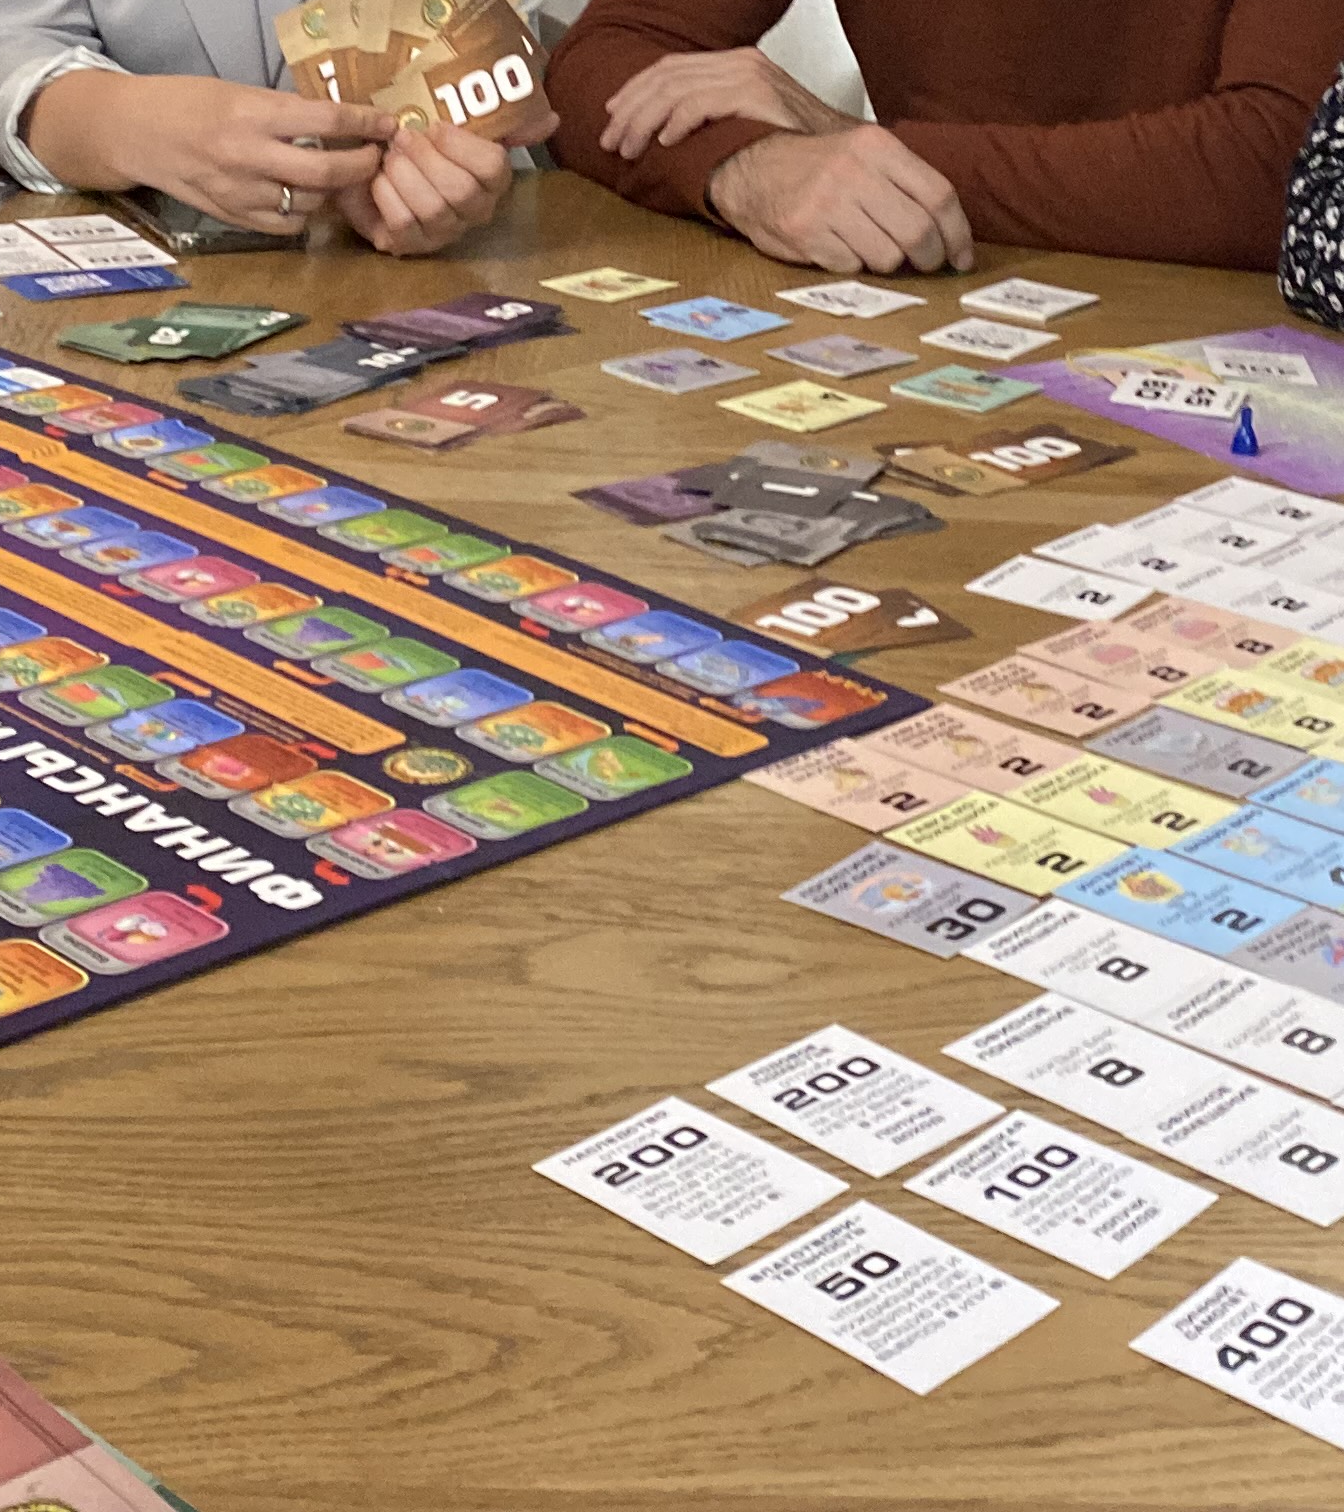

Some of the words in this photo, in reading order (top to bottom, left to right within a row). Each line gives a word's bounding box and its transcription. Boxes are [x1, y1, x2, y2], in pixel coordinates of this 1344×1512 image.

[434, 53, 534, 127] 100
[440, 390, 500, 411] 5
[970, 435, 1083, 473] 100
[1140, 557, 1179, 573] 2
[1076, 589, 1116, 606] 2
[1269, 595, 1310, 612] 2
[756, 586, 882, 637] 100
[1147, 665, 1189, 683] 8
[1072, 701, 1117, 721] 2
[1293, 715, 1335, 734] 8
[998, 754, 1047, 777] 2
[1227, 758, 1273, 780] 2
[879, 790, 930, 812] 2
[1149, 810, 1201, 833] 2
[1035, 850, 1088, 875] 2
[924, 897, 1008, 942] 30
[1209, 907, 1265, 934] 2
[1095, 955, 1150, 983] 8
[1281, 1026, 1339, 1056] 8
[771, 1055, 882, 1111] 200
[1088, 1057, 1148, 1088] 8
[592, 1125, 710, 1189] 200
[1278, 1143, 1341, 1176] 8
[983, 1143, 1080, 1201] 100
[814, 1250, 902, 1302] 50
[1216, 1296, 1316, 1374] 400
